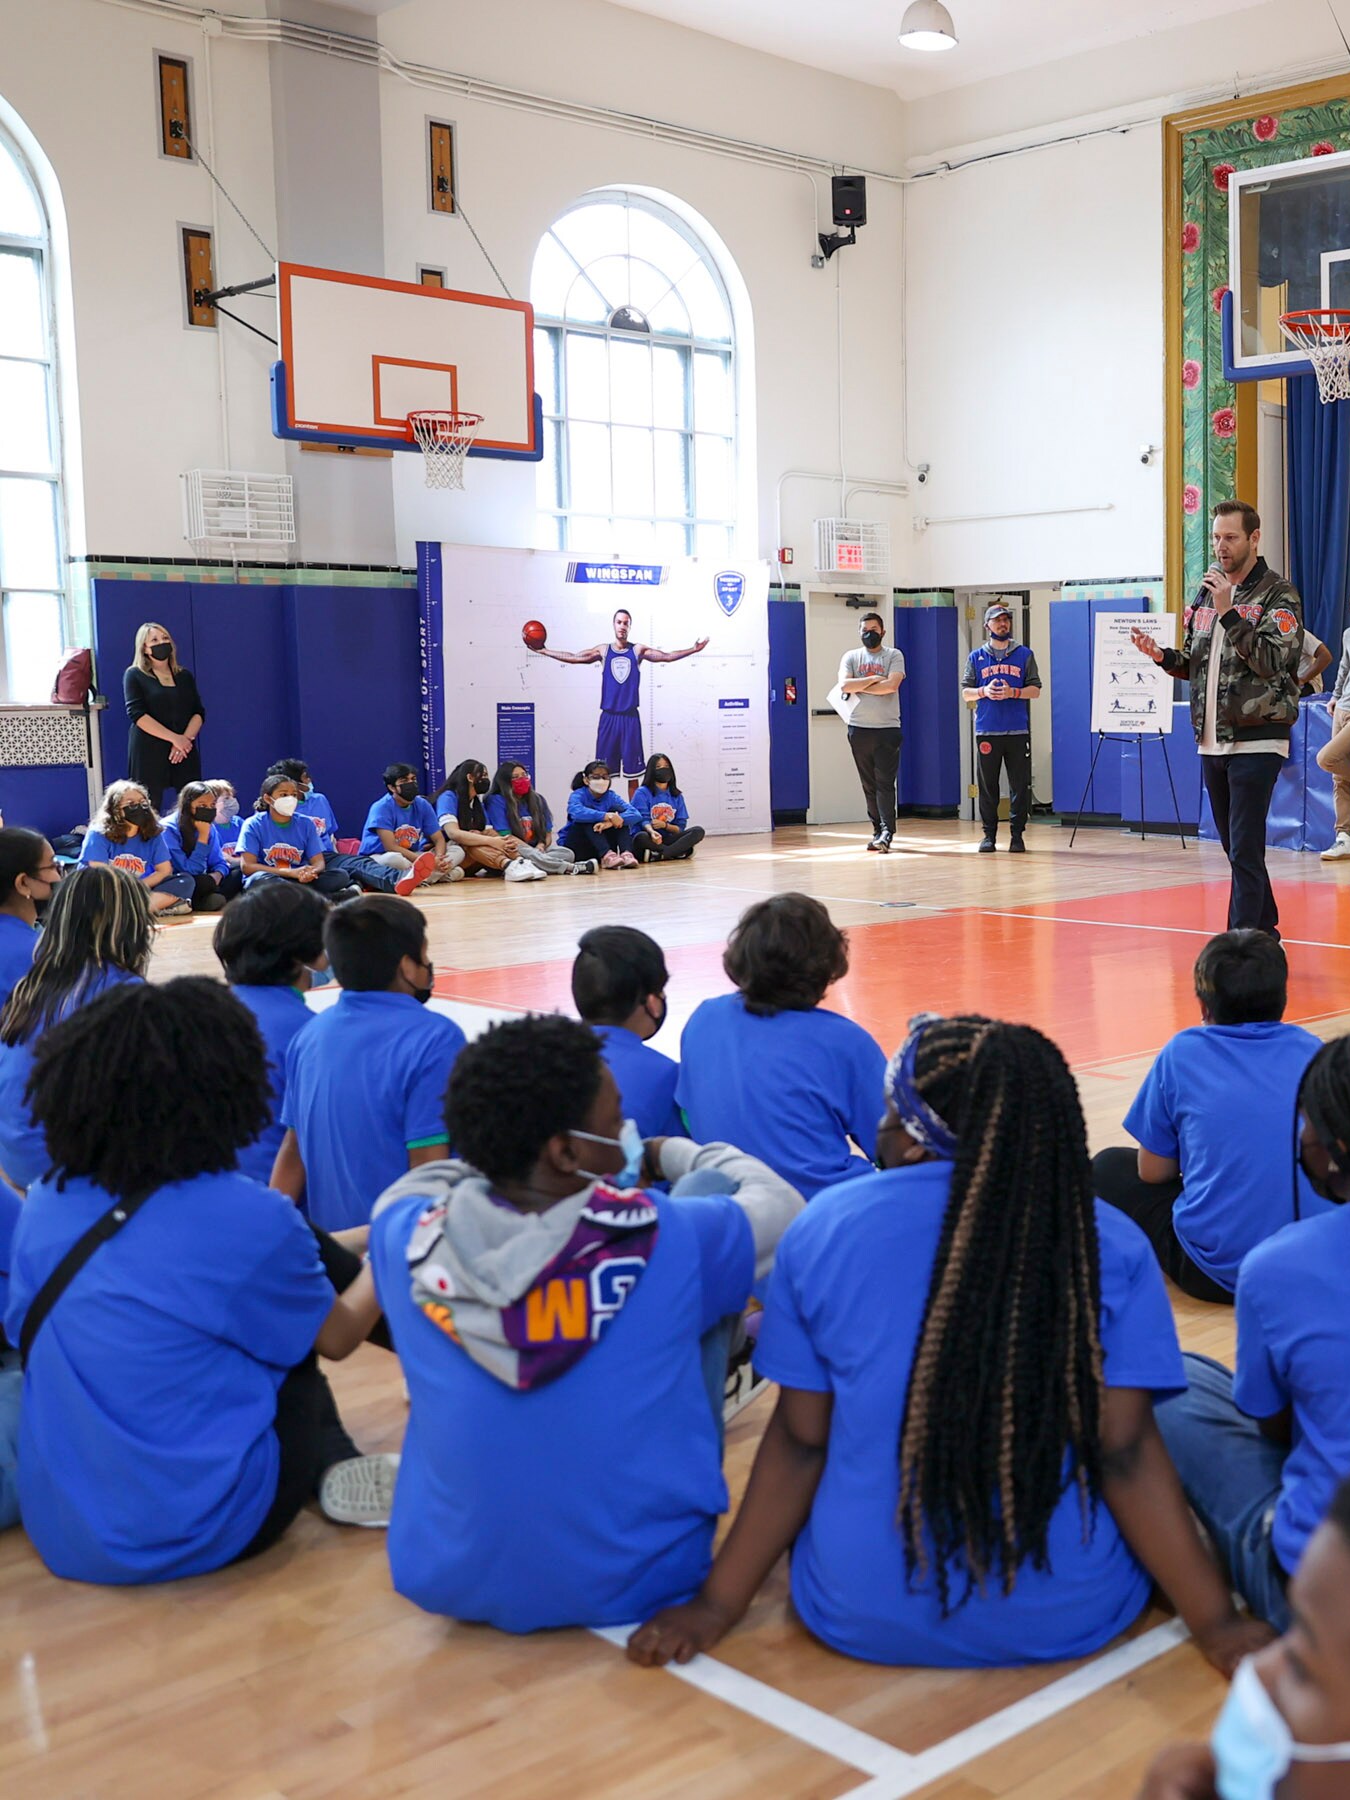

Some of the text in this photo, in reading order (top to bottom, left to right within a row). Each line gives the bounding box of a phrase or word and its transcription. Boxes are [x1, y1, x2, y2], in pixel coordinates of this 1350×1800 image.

[585, 567, 653, 581] WINGSPAN
[419, 617, 430, 771] SCIENCE OF SPORT
